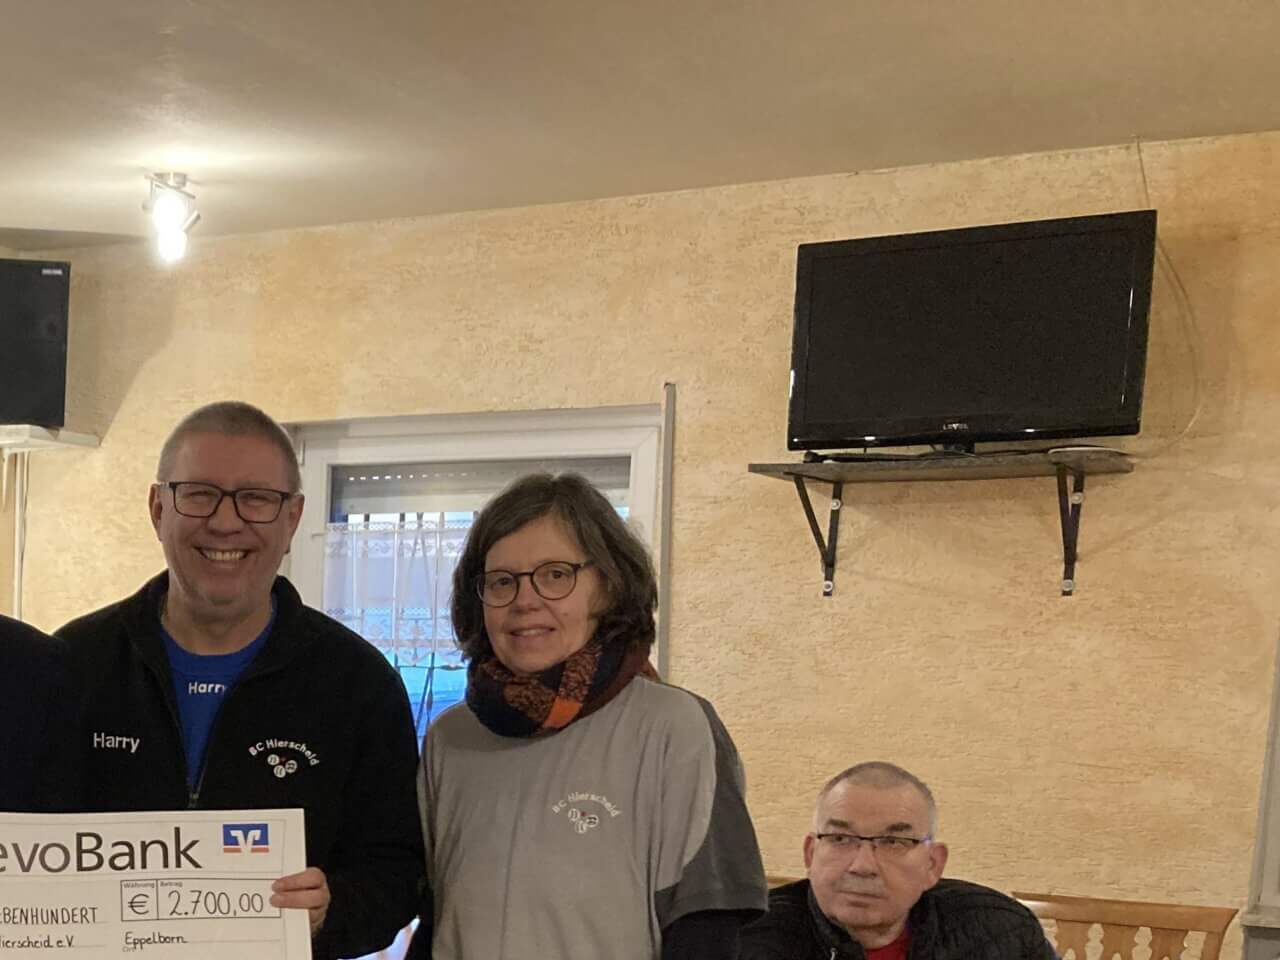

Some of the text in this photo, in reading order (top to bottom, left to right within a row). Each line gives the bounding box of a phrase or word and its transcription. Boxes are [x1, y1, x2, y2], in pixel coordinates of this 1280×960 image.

[93, 732, 140, 753] Harry
[248, 742, 265, 756] BC
[127, 889, 264, 917] € 2.700,00
[124, 931, 188, 950] Eppelborn
